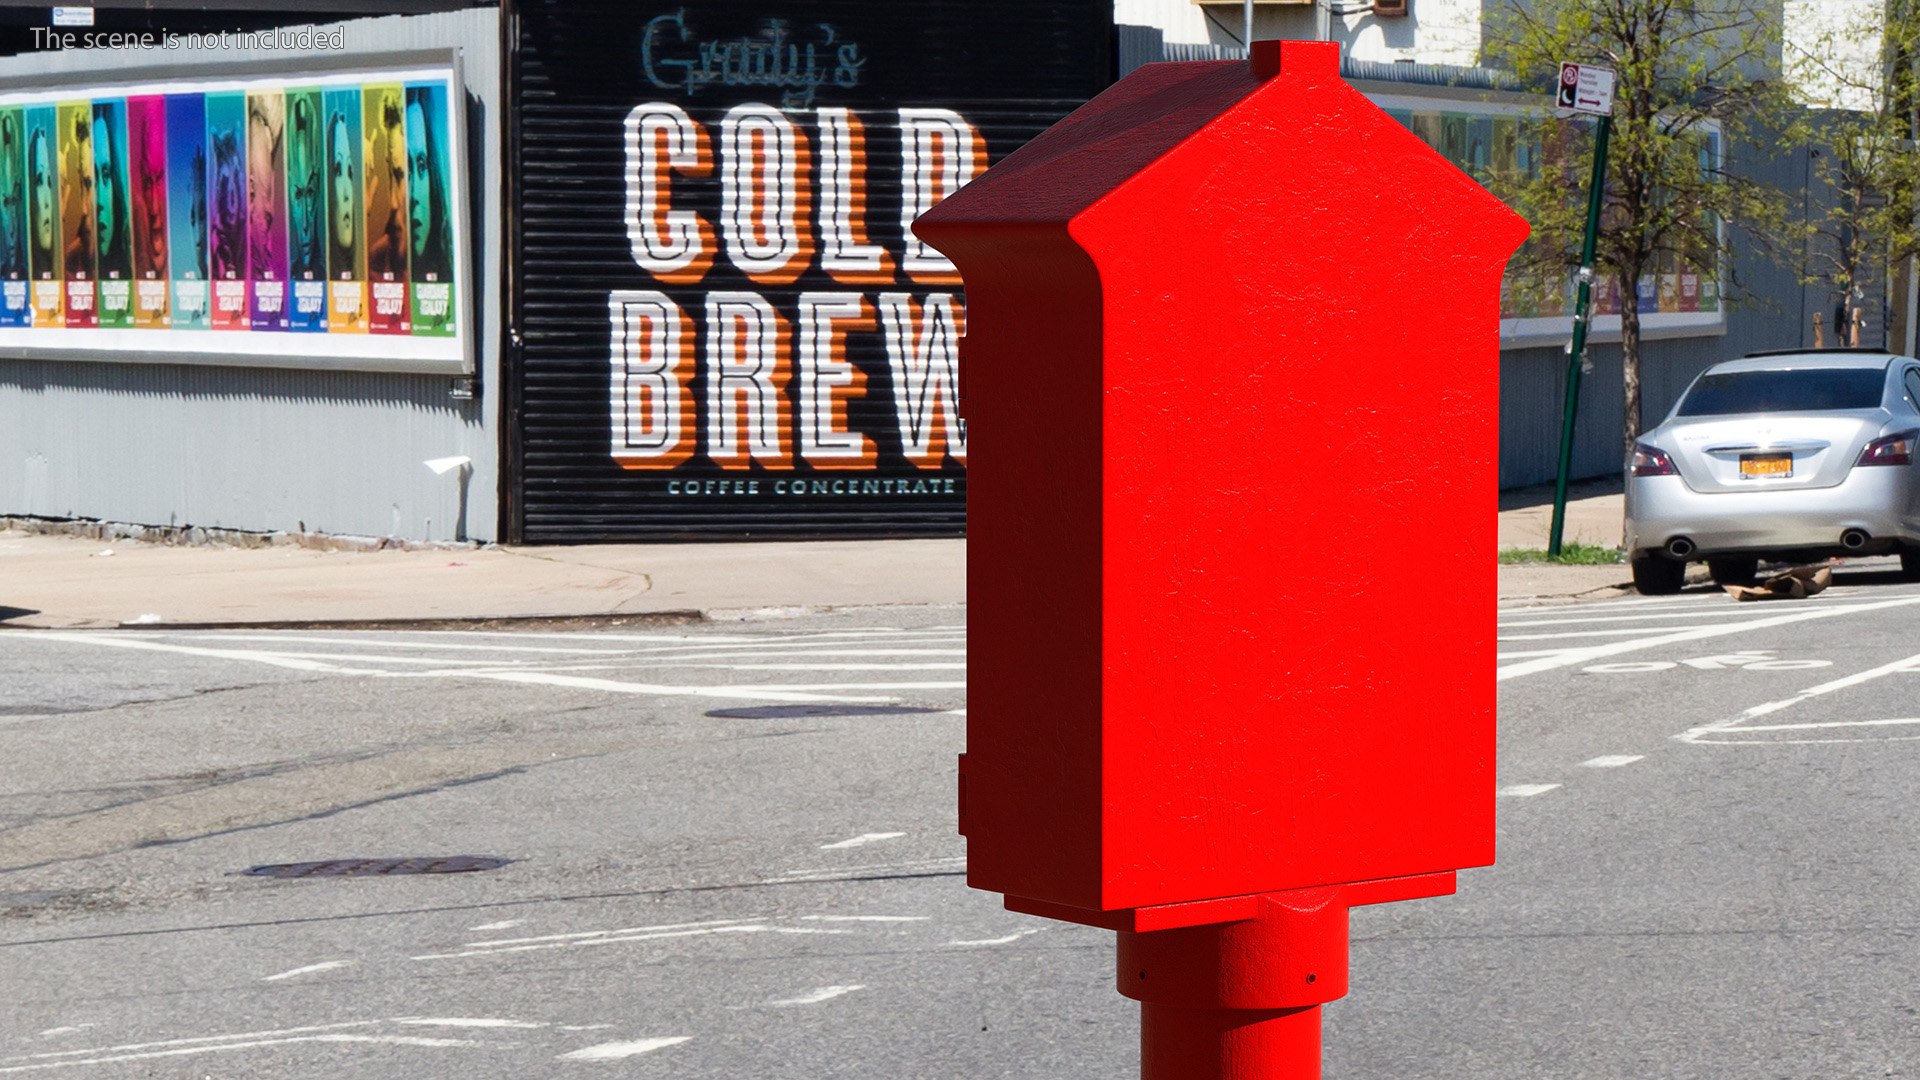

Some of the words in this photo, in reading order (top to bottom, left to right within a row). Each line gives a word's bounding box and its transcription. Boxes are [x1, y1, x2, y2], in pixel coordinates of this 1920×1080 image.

[641, 8, 867, 109] Grady's
[624, 102, 989, 284] COLD
[609, 289, 967, 471] BREW
[667, 479, 760, 496] COFFEE
[773, 478, 956, 495] CONCENTRATE
